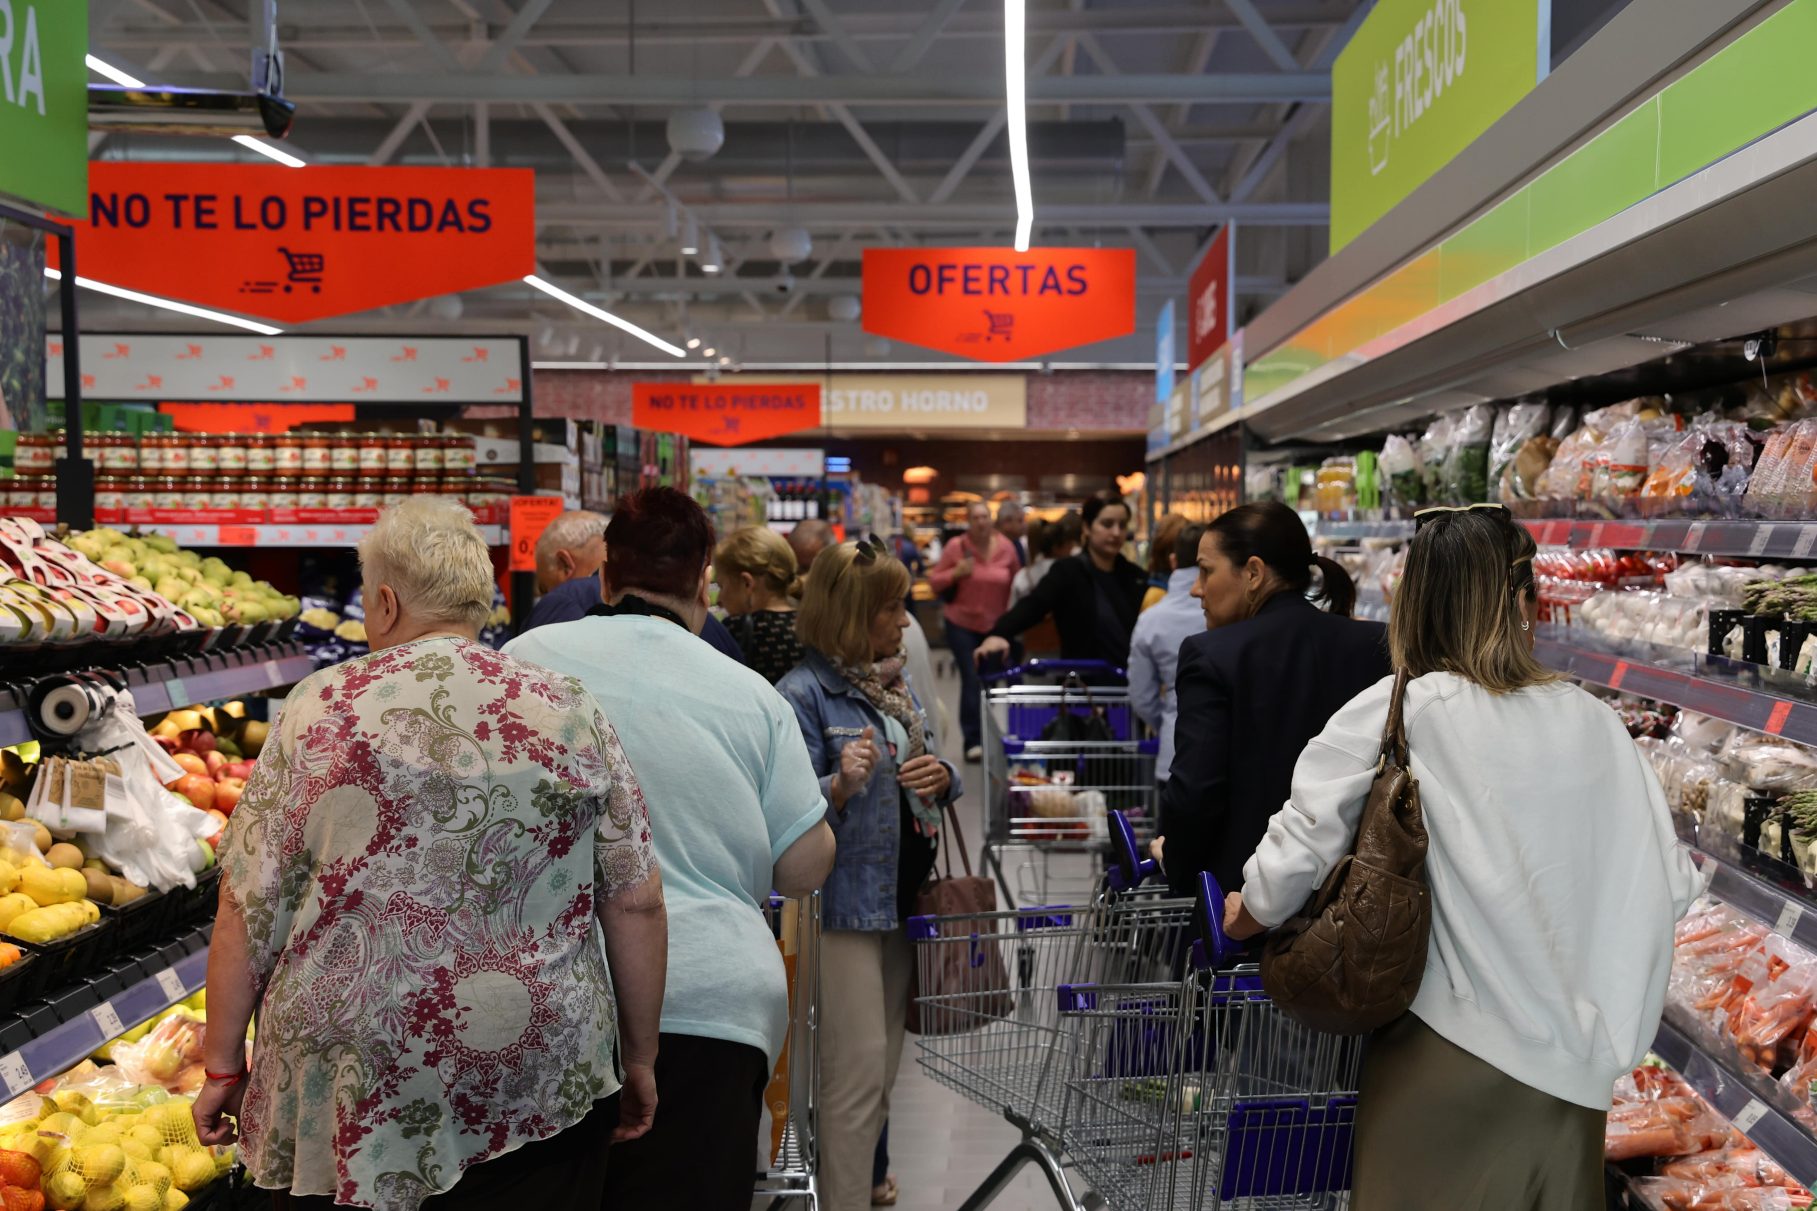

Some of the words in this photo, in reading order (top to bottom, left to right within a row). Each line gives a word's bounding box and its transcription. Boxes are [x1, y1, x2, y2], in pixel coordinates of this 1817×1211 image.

[1394, 0, 1467, 138] FRESCOS
[91, 192, 151, 229] NO
[164, 193, 218, 230] TE
[233, 194, 287, 231] LO
[302, 195, 493, 233] PIERDAS
[908, 263, 1089, 296] OFERTAS
[649, 395, 674, 409] NO
[679, 395, 698, 410] TE
[704, 395, 727, 409] LO
[731, 395, 806, 410] PIERDAS
[901, 391, 988, 413] HORNO
